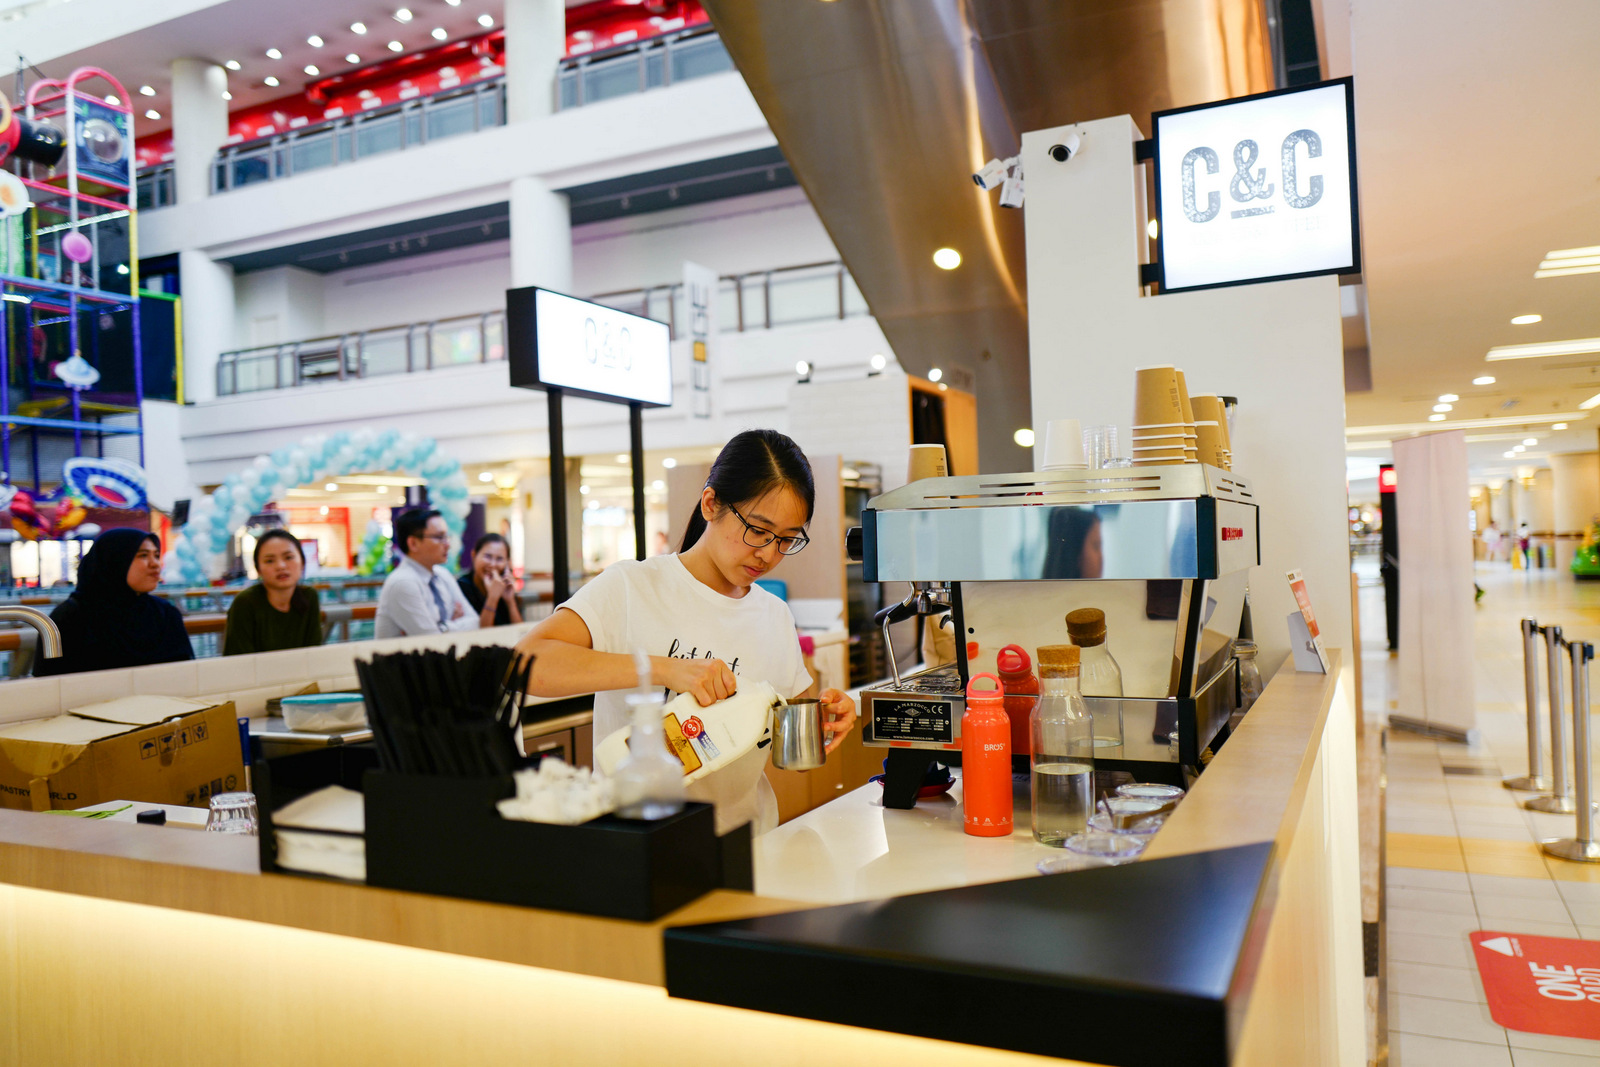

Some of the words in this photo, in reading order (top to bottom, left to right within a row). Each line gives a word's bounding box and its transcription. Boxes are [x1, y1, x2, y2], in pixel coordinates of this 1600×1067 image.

[1181, 129, 1324, 224] C&C
[584, 316, 633, 372] C&C
[0, 784, 31, 797] PASTRY
[1528, 961, 1586, 1001] ONE
